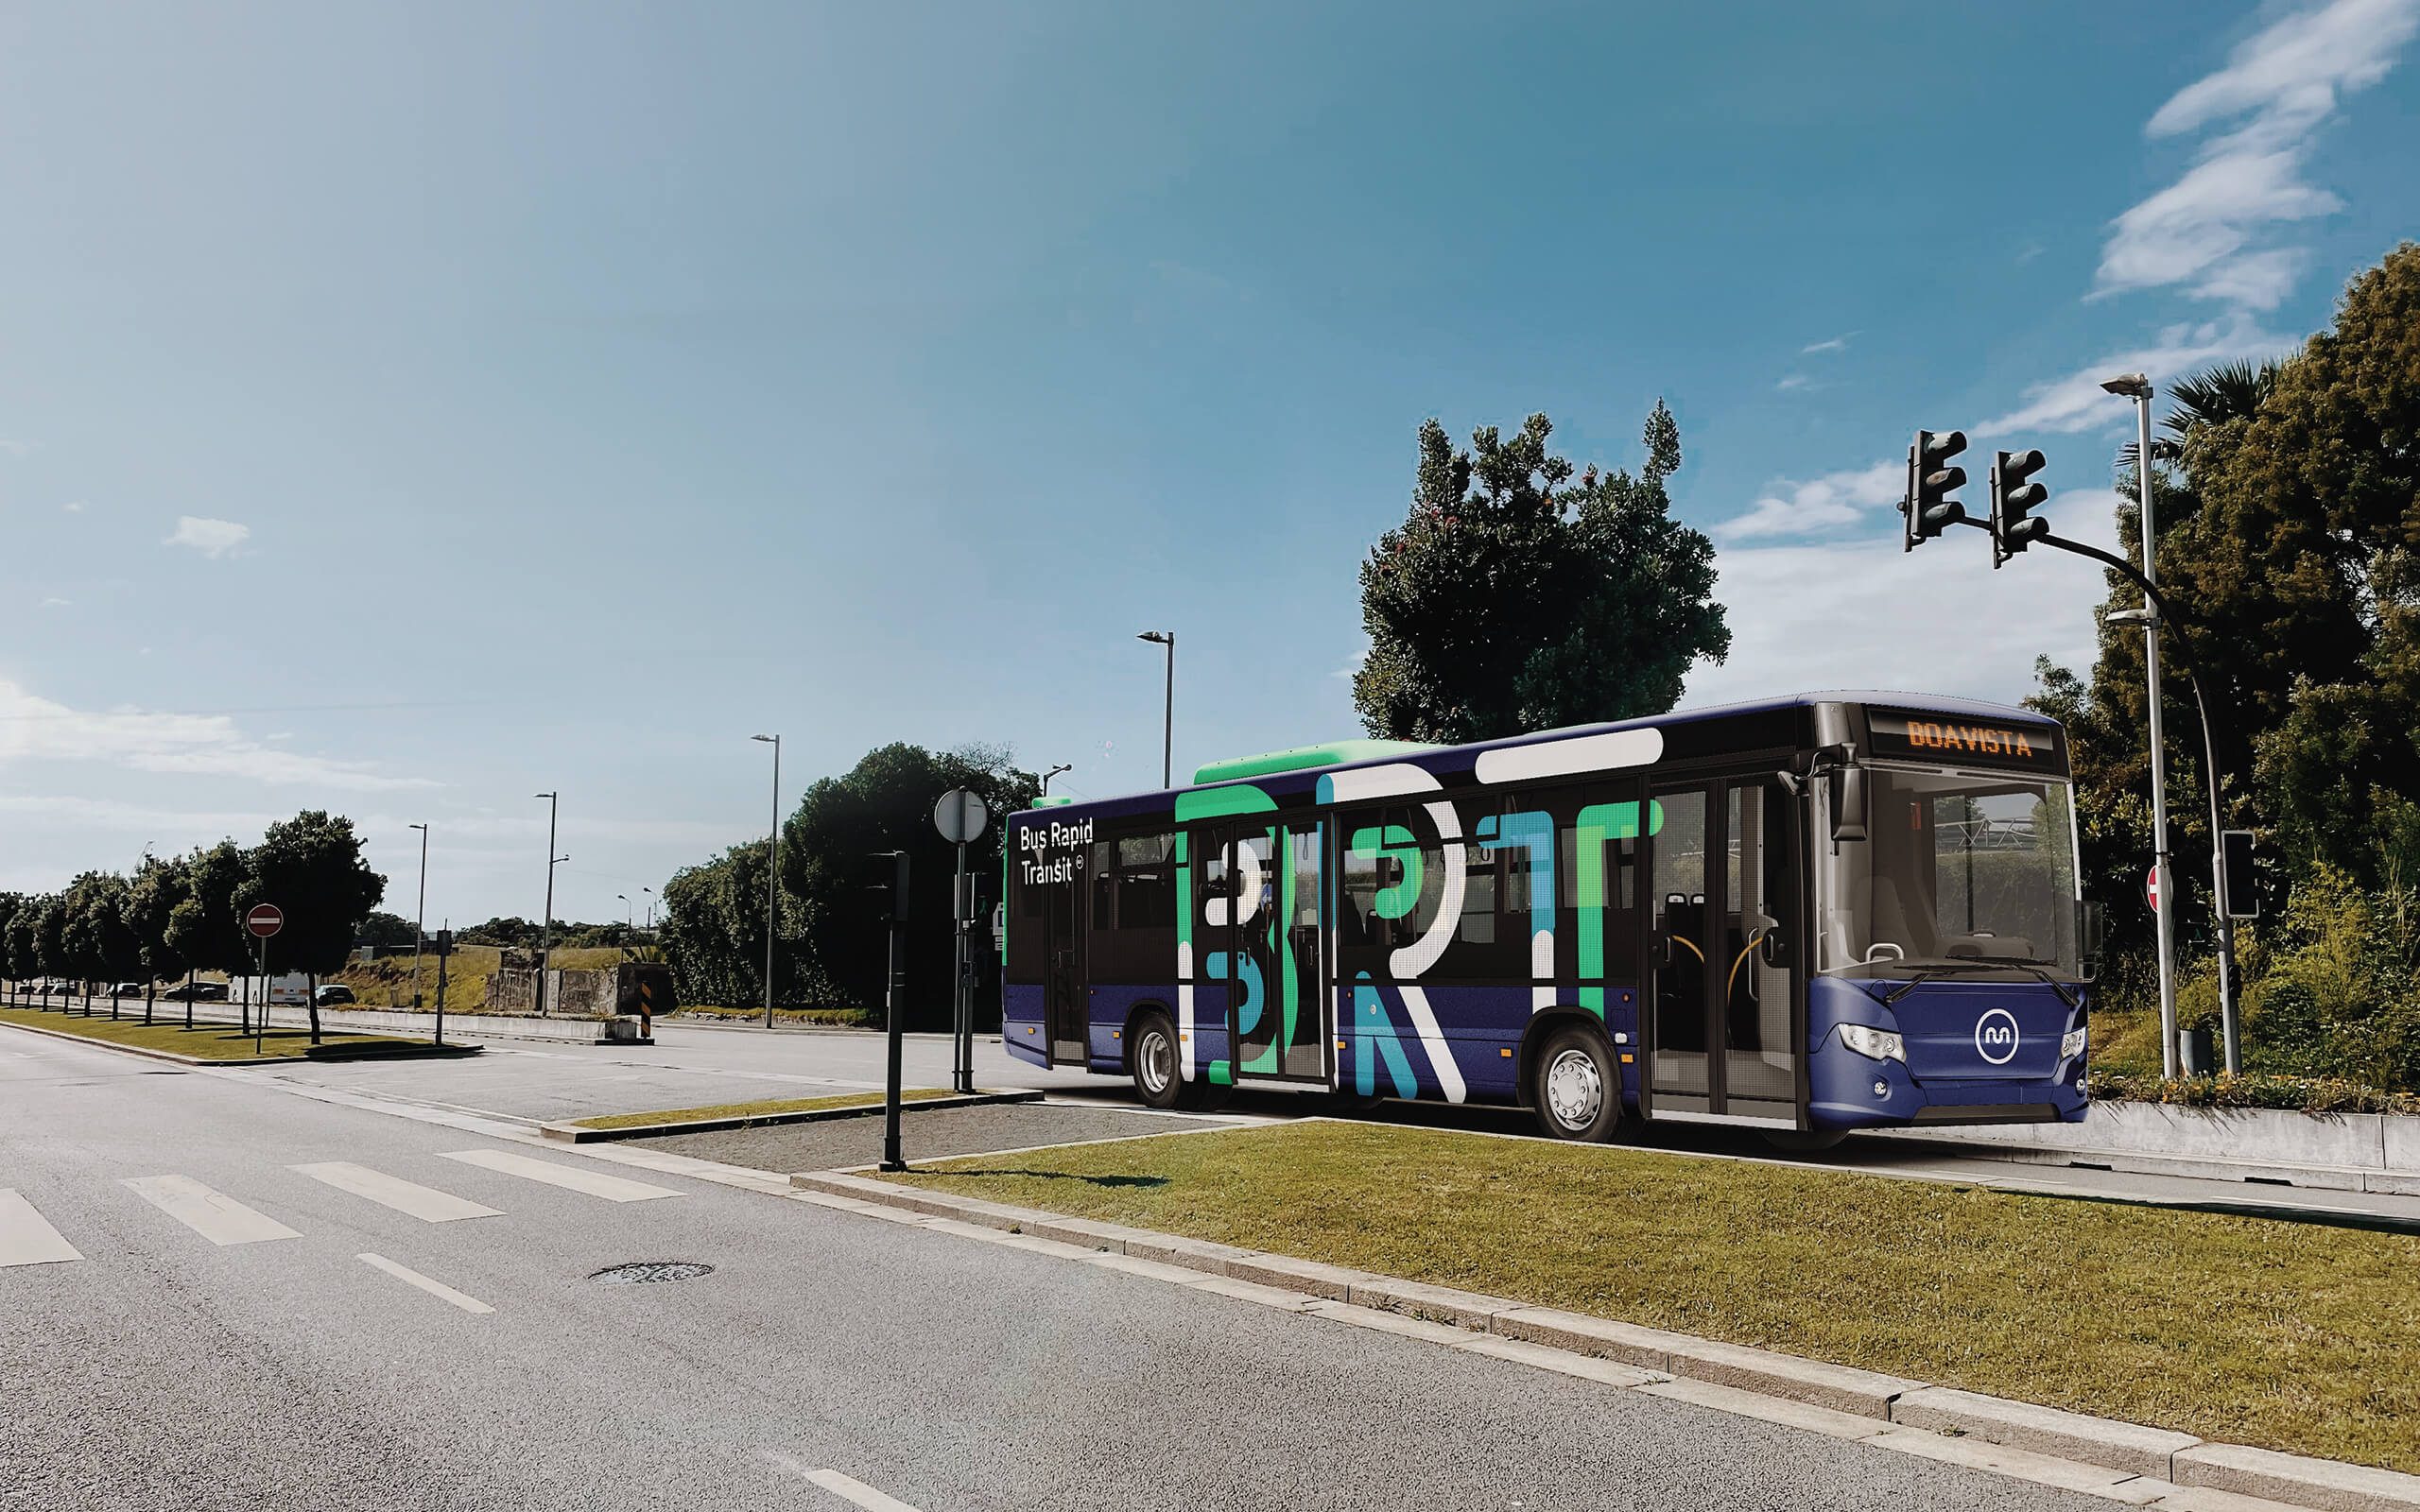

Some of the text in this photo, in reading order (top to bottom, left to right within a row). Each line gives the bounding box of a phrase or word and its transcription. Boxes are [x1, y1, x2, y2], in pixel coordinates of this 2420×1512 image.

[1907, 721, 2031, 756] BOAVISTA
[1021, 816, 1093, 851] Bus Rapid
[1021, 856, 1072, 885] Transit
